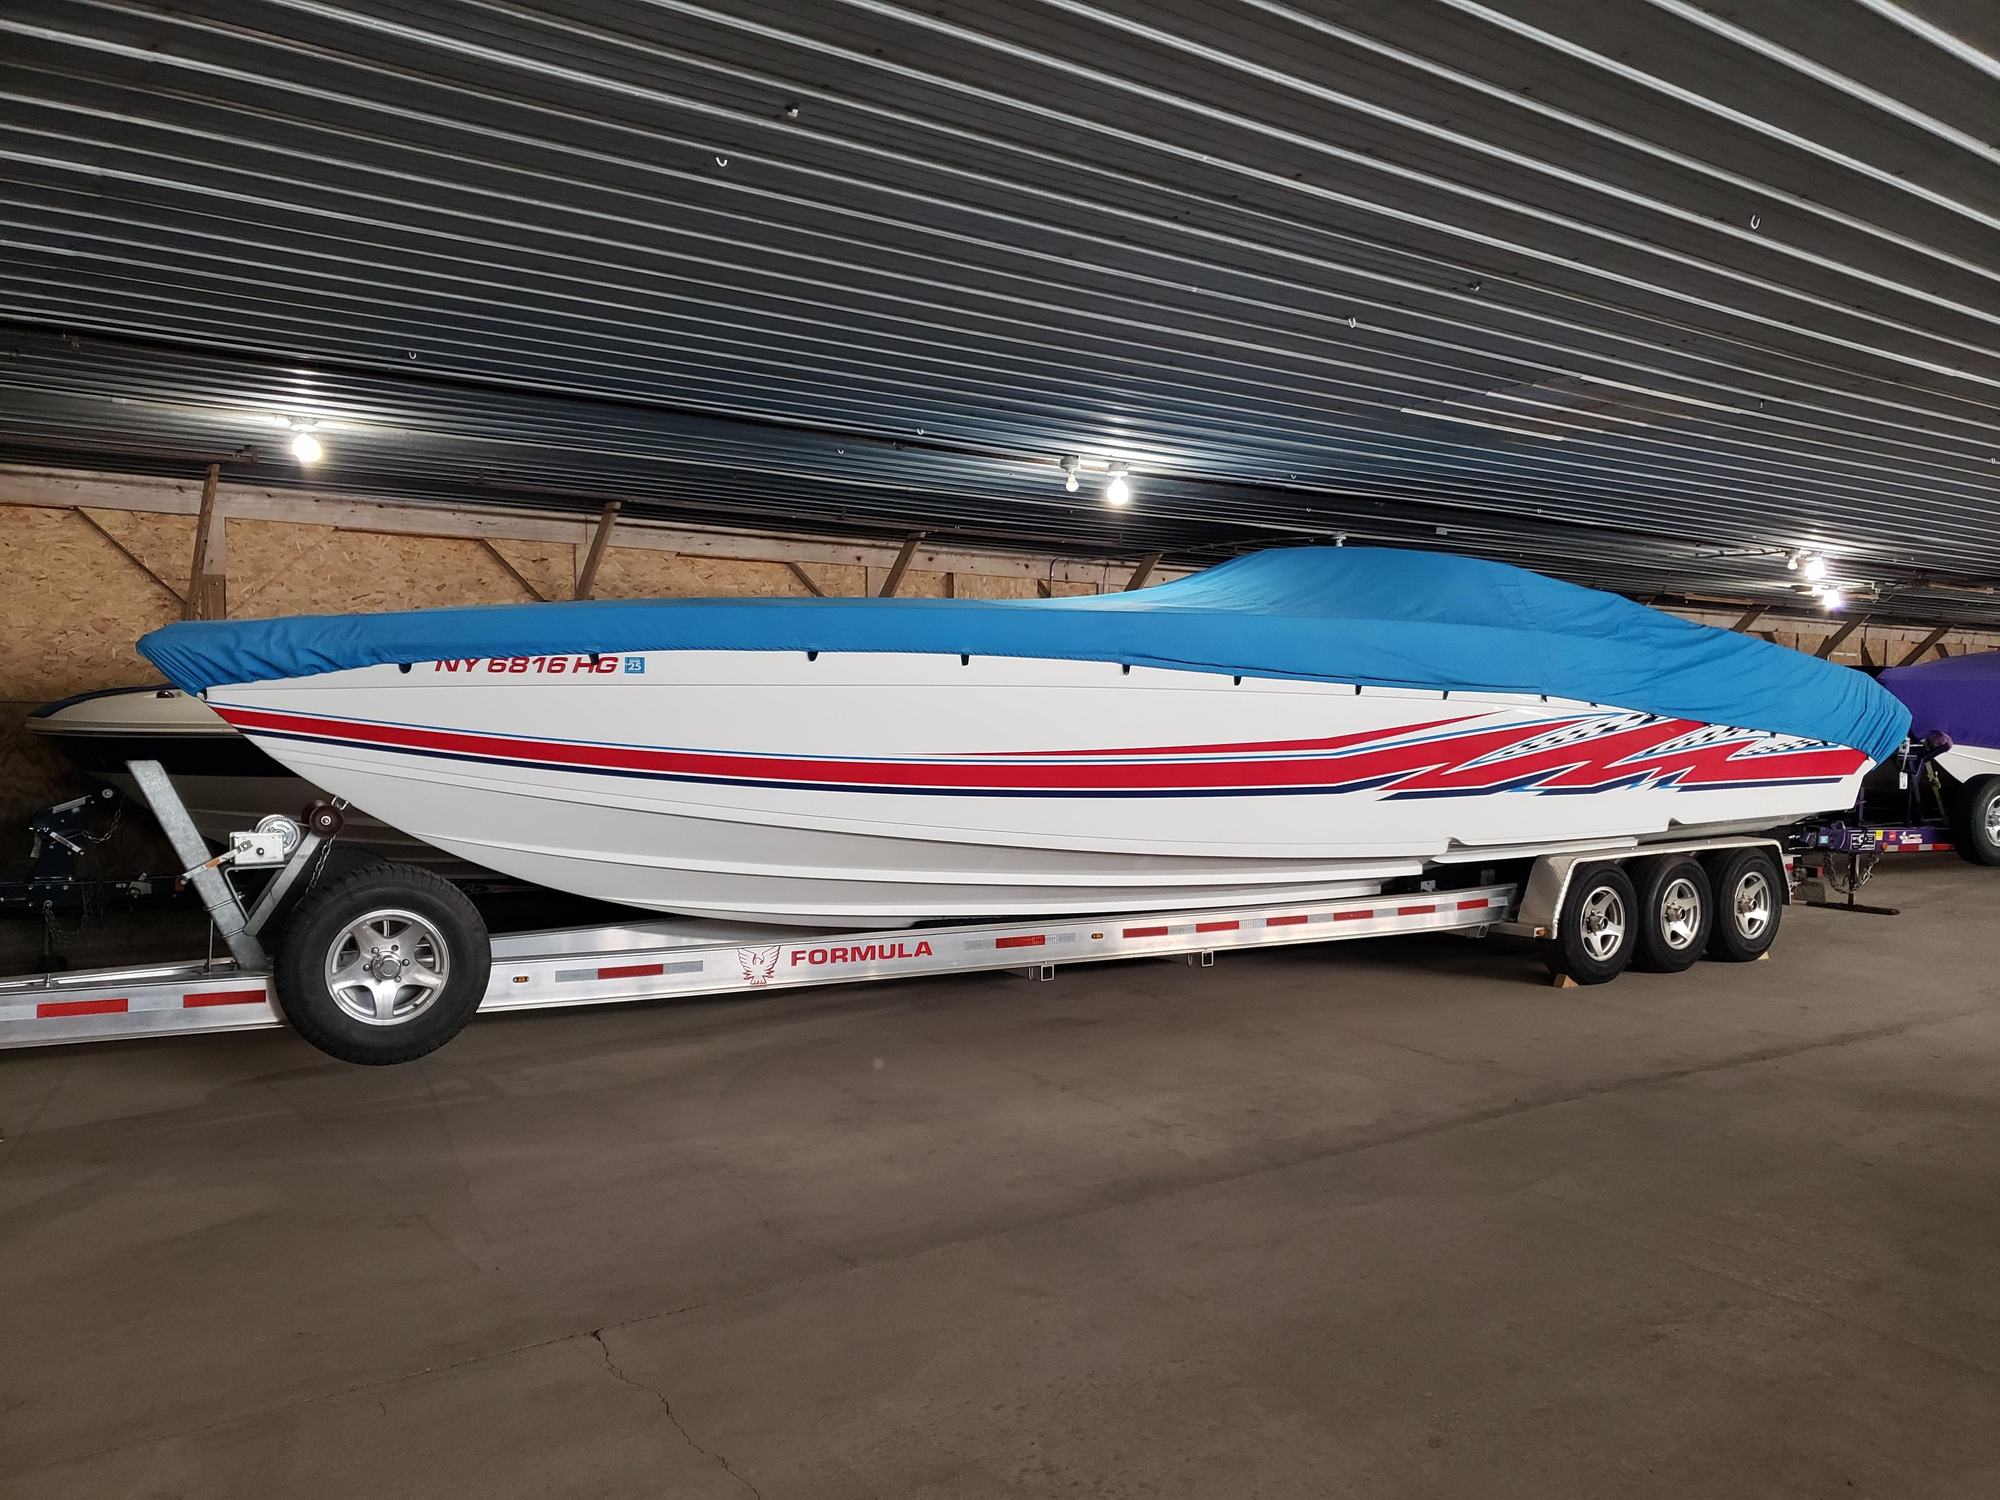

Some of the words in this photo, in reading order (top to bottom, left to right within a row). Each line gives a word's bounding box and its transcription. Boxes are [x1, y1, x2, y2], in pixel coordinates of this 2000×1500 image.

[434, 657, 481, 672] NY
[487, 656, 569, 674] 6816
[572, 656, 619, 674] HG
[790, 941, 933, 967] FORMULA
